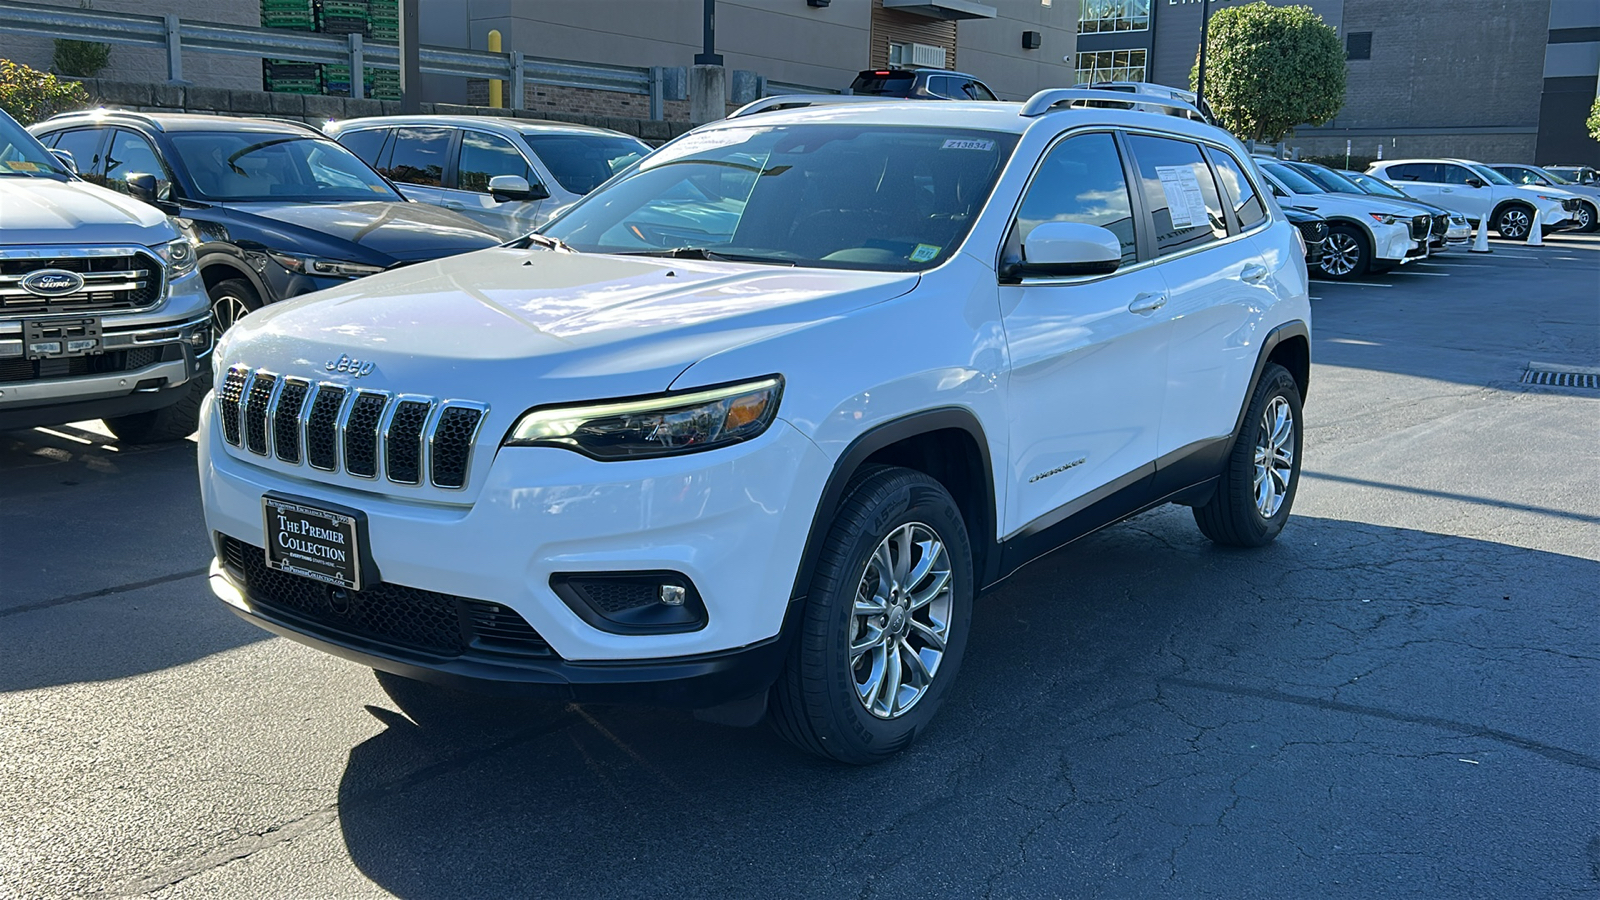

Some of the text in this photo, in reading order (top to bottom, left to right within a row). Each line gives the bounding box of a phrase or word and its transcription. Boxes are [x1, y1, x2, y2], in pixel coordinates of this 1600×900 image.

[948, 141, 987, 150] Z13834
[39, 275, 71, 288] Ford
[325, 353, 376, 378] Jeep
[277, 514, 345, 544] THE PREMIER
[278, 531, 346, 562] COLLECTION
